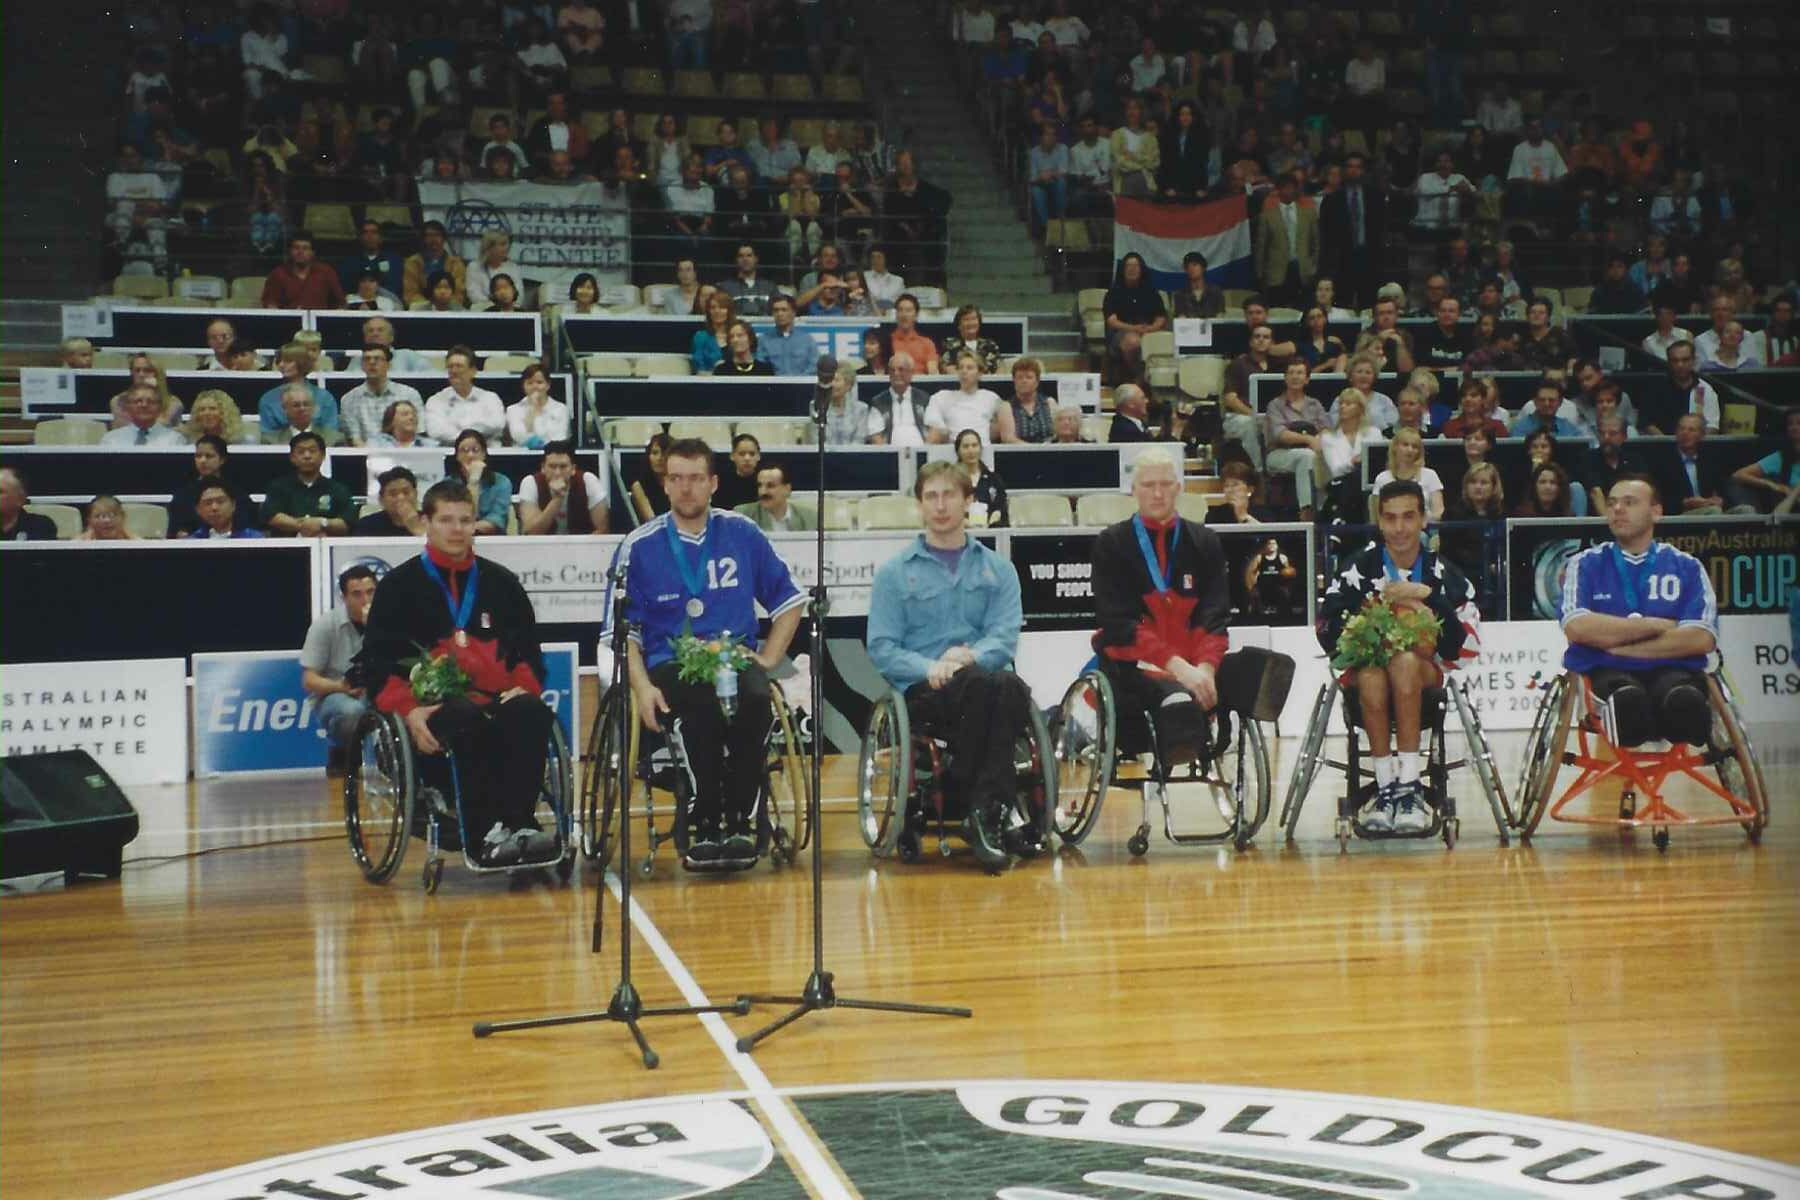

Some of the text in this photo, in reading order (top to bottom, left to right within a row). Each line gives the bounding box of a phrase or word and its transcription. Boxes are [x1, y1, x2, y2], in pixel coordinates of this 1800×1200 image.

[516, 202, 602, 225] STATE
[707, 557, 738, 590] 12
[1029, 564, 1055, 579] YOU
[1648, 574, 1681, 601] 10
[207, 689, 328, 738] Ener
[226, 1121, 689, 1200] tralia
[999, 1095, 1777, 1200] GOLDCUP
